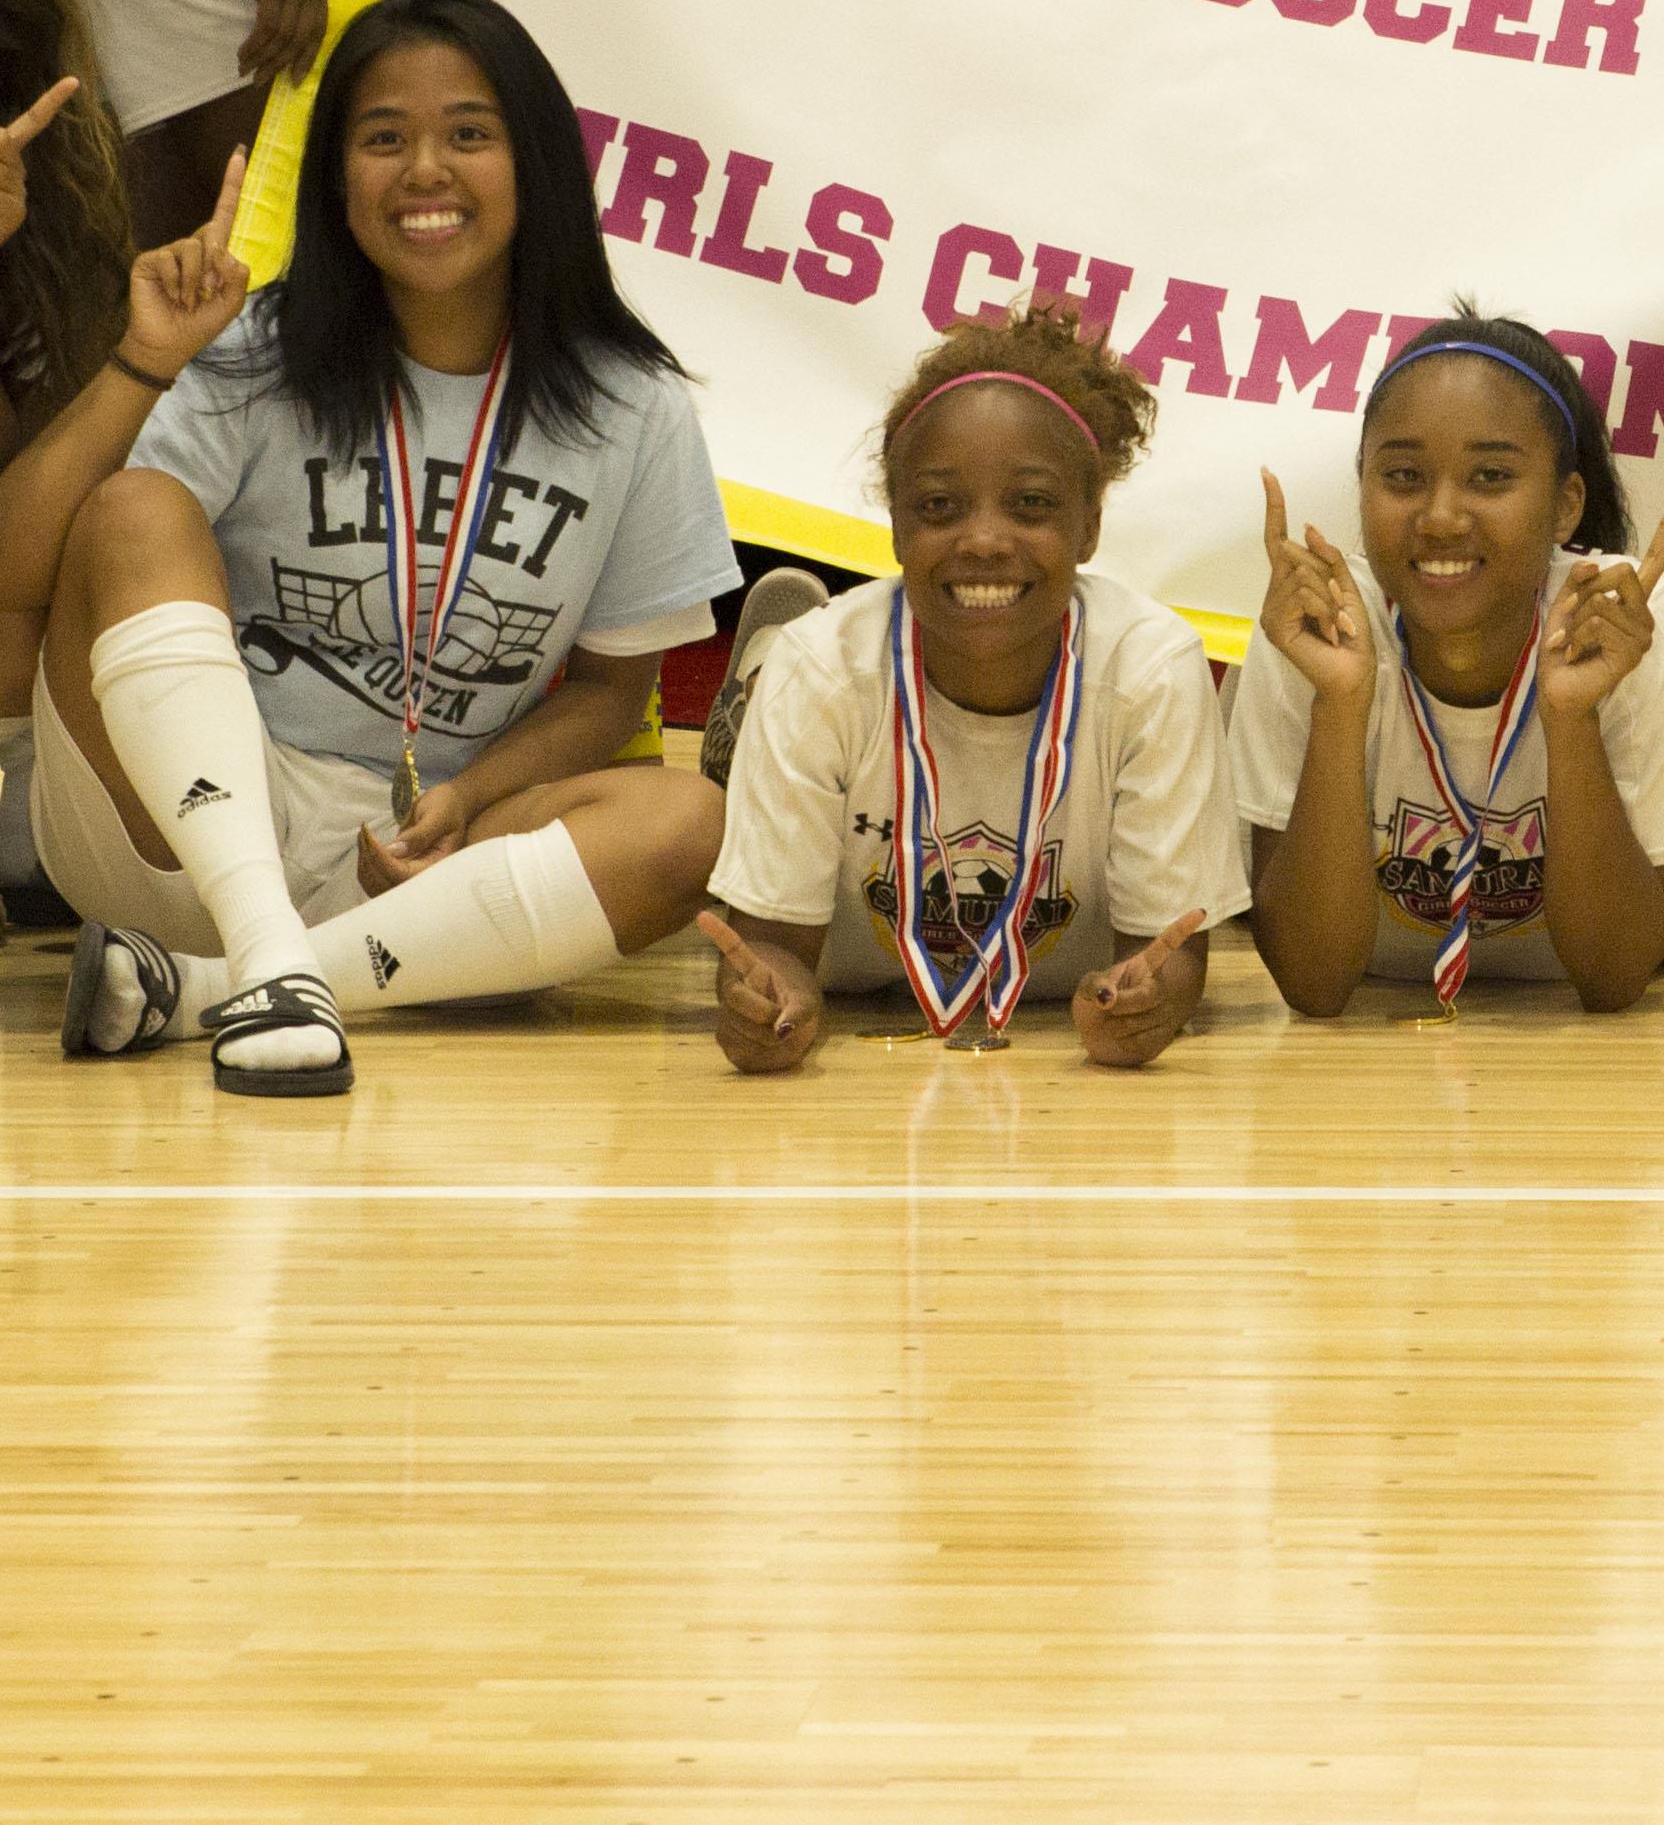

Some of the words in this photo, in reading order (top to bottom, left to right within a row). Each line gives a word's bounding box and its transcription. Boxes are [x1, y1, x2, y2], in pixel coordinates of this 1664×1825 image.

[574, 106, 895, 306] RLS
[177, 790, 233, 819] adidas
[1383, 860, 1544, 896] SAMURA
[873, 885, 1064, 927] SMUAI
[366, 934, 388, 991] adidas
